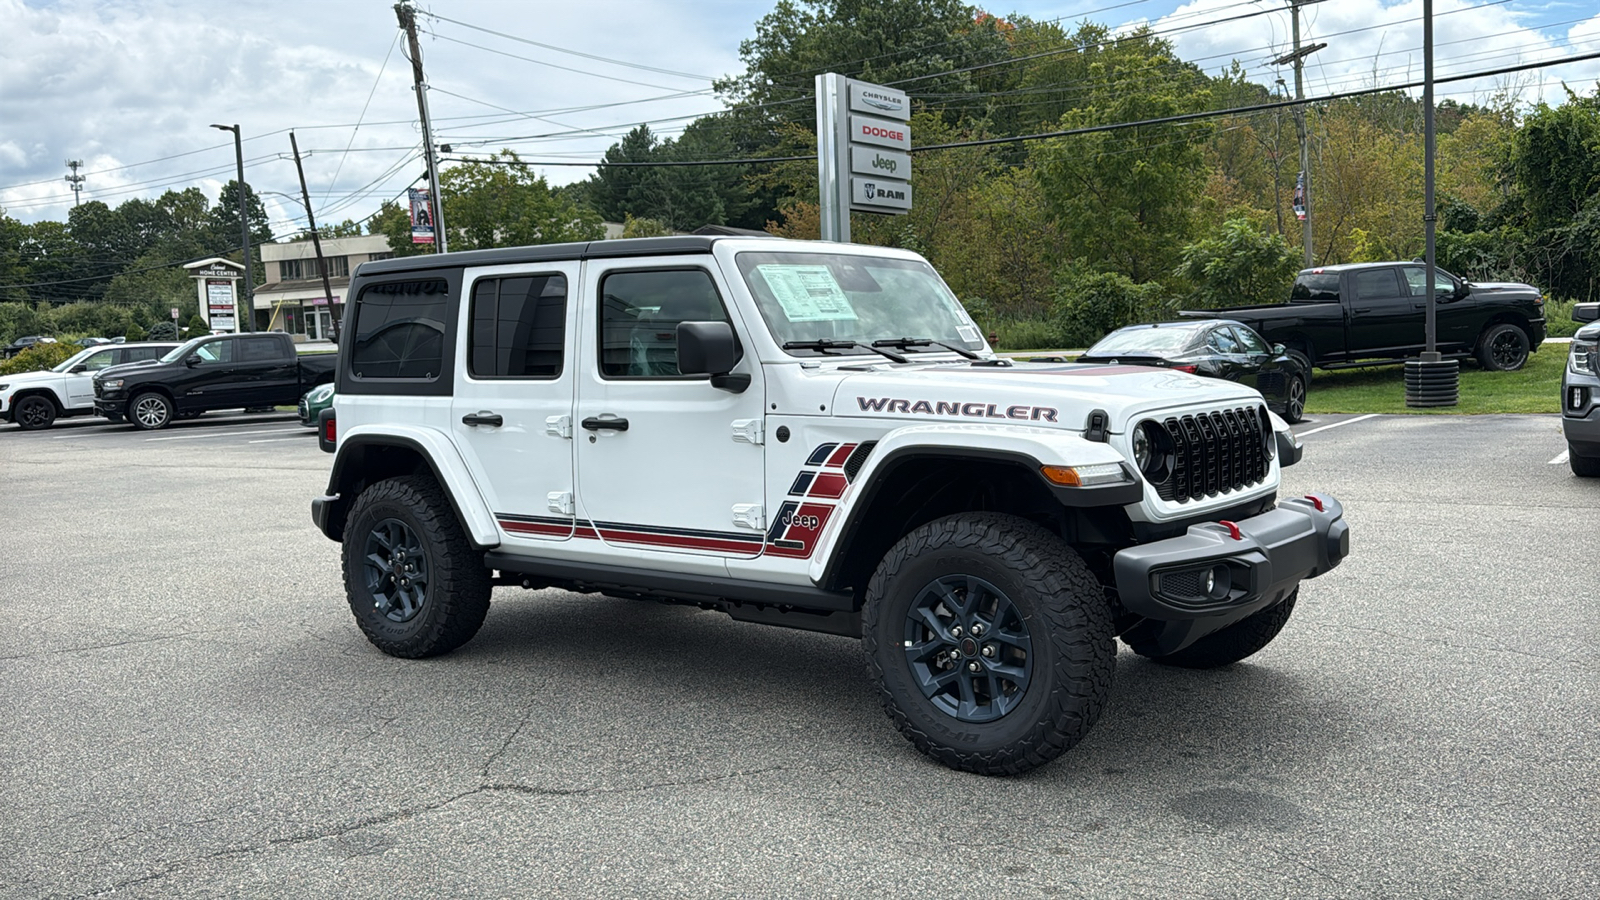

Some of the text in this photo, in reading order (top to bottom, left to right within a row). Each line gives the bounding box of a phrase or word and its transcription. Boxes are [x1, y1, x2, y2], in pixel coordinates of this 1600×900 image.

[863, 92, 902, 104] CHRYSLER
[863, 126, 904, 141] DODGE
[872, 153, 897, 173] Jeep
[877, 189, 905, 200] RAM
[857, 396, 1059, 422] WRANGLER
[782, 510, 820, 530] Jeep
